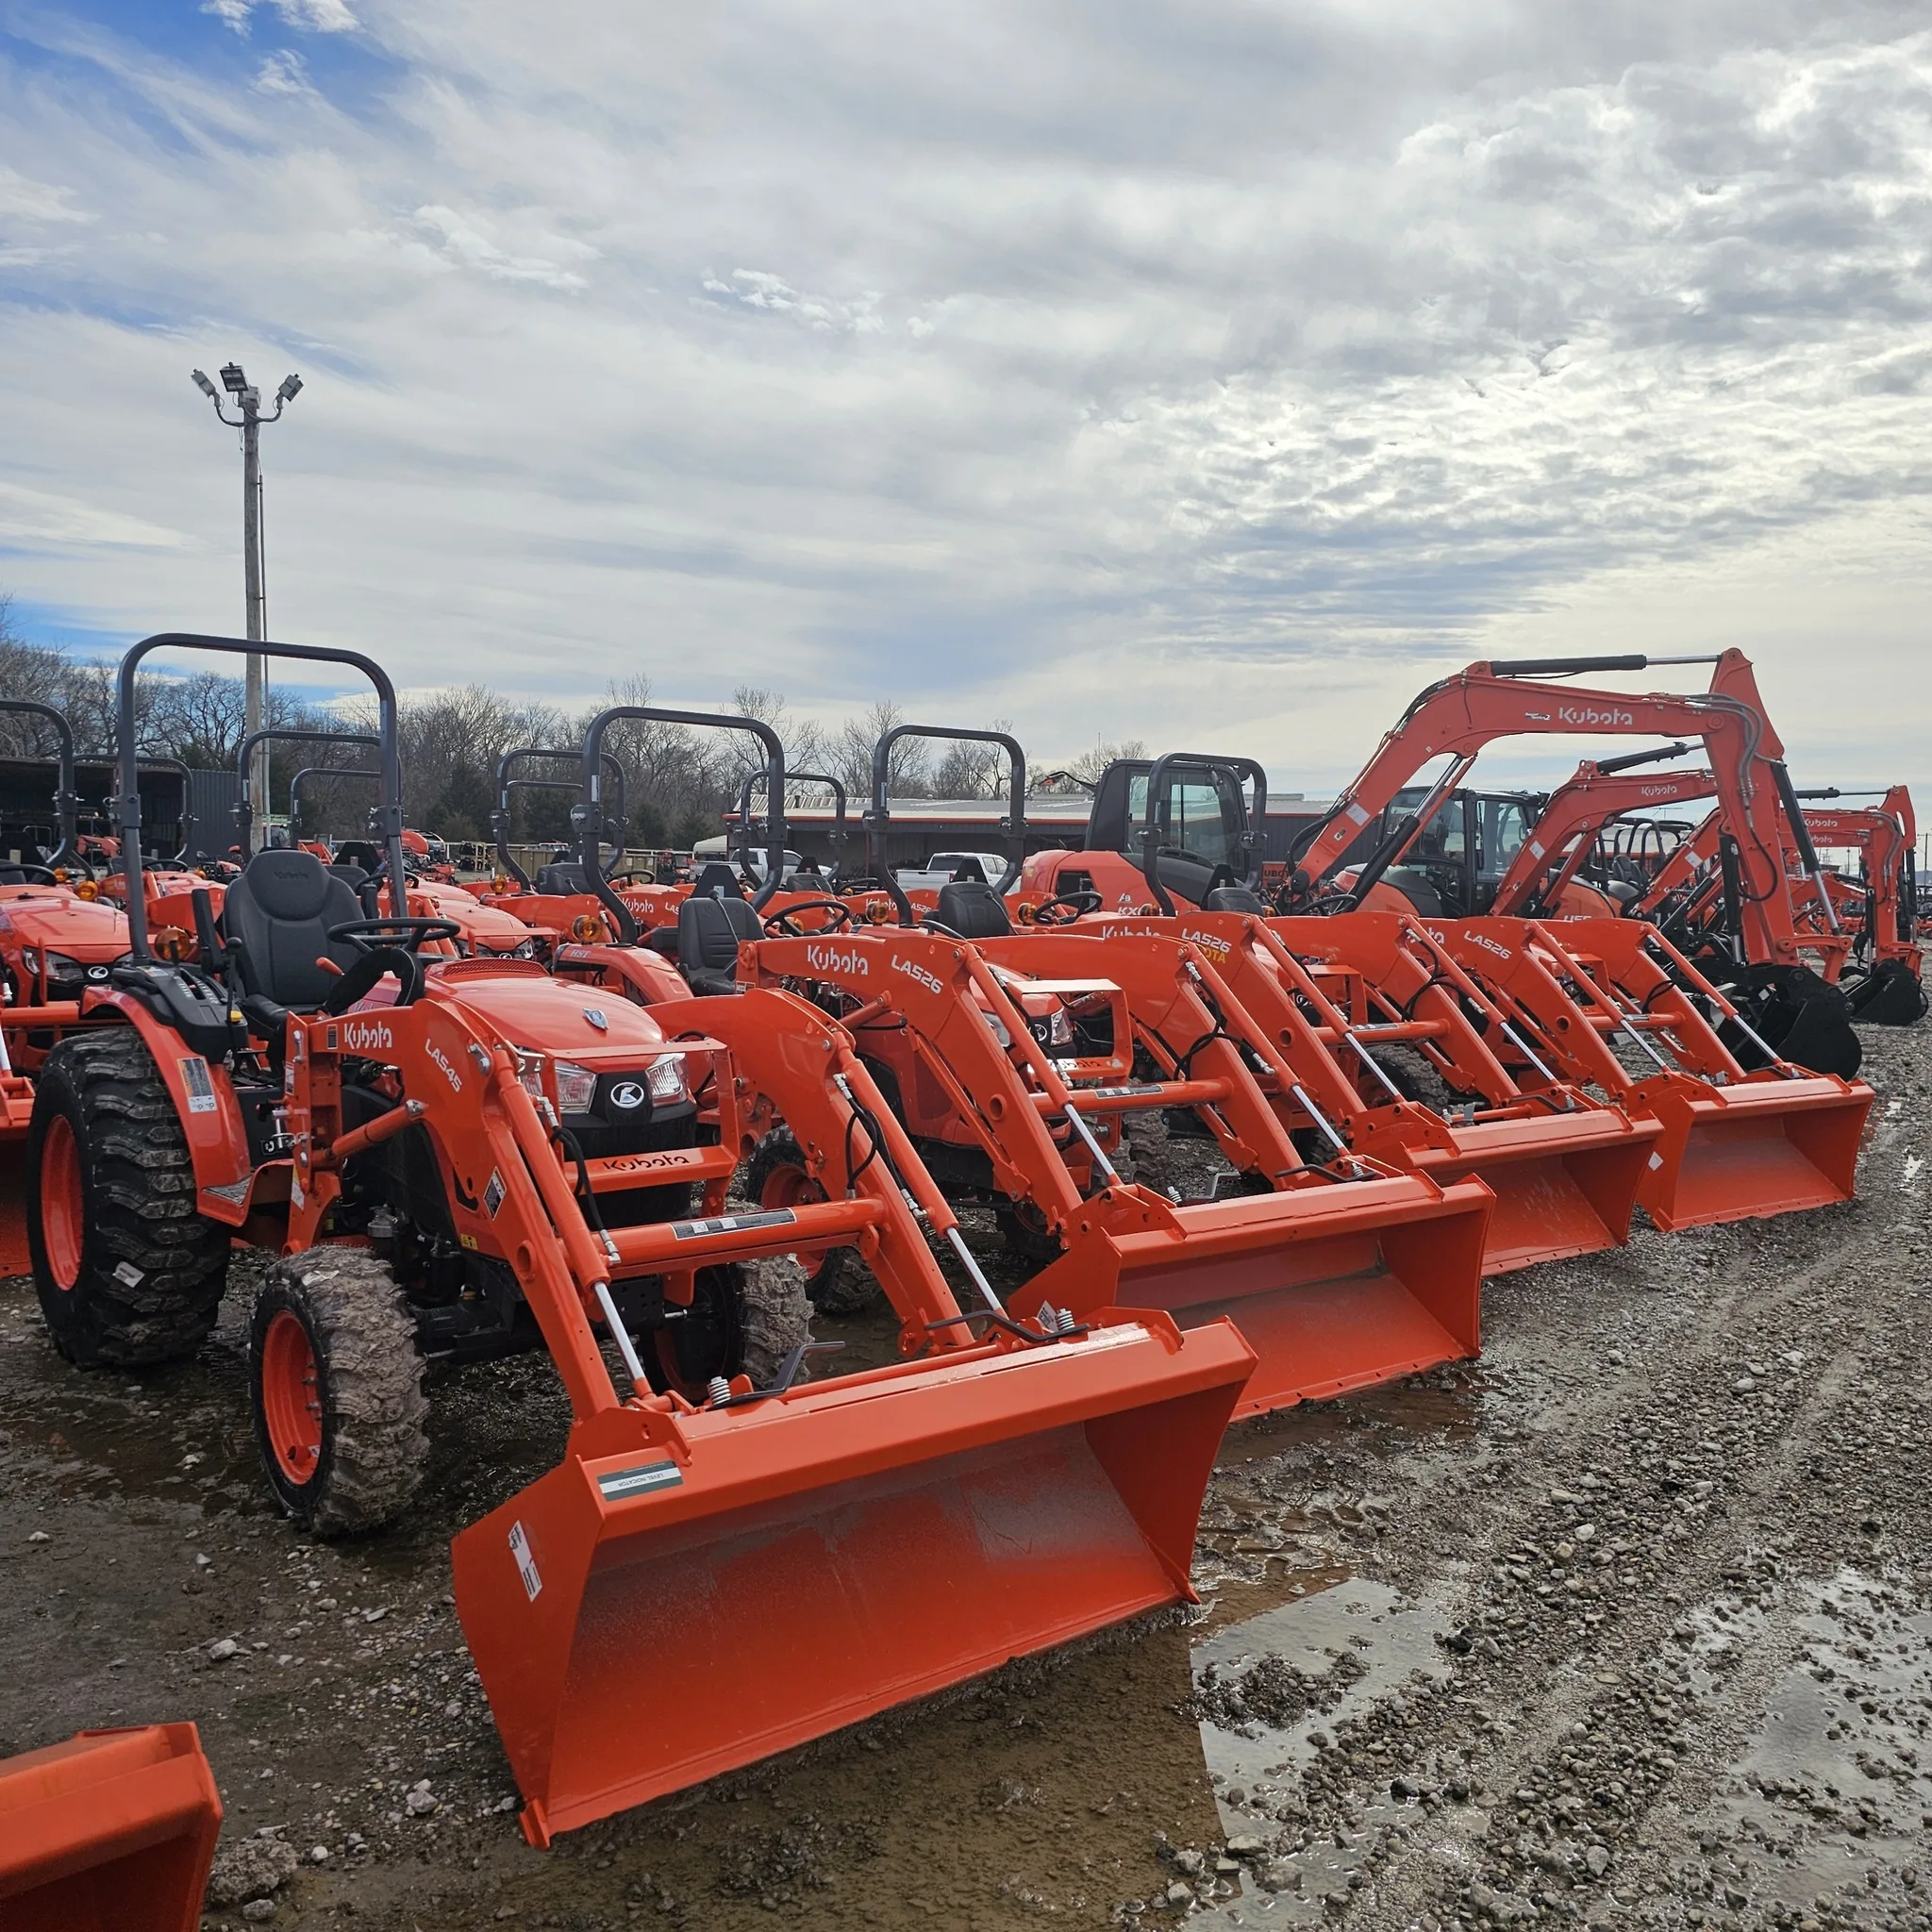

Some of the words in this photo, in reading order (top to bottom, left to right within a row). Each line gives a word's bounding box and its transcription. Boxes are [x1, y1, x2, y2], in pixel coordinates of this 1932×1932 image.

[1558, 707, 1633, 725] Kubota
[1641, 784, 1677, 796] Kubota
[1181, 928, 1232, 954] LA526
[1463, 930, 1512, 959] LA526
[808, 944, 869, 975] Kubota
[891, 955, 944, 994] LA526
[343, 1021, 392, 1049] Kubota
[425, 1038, 462, 1092] LA545
[602, 1155, 690, 1171] Kubota
